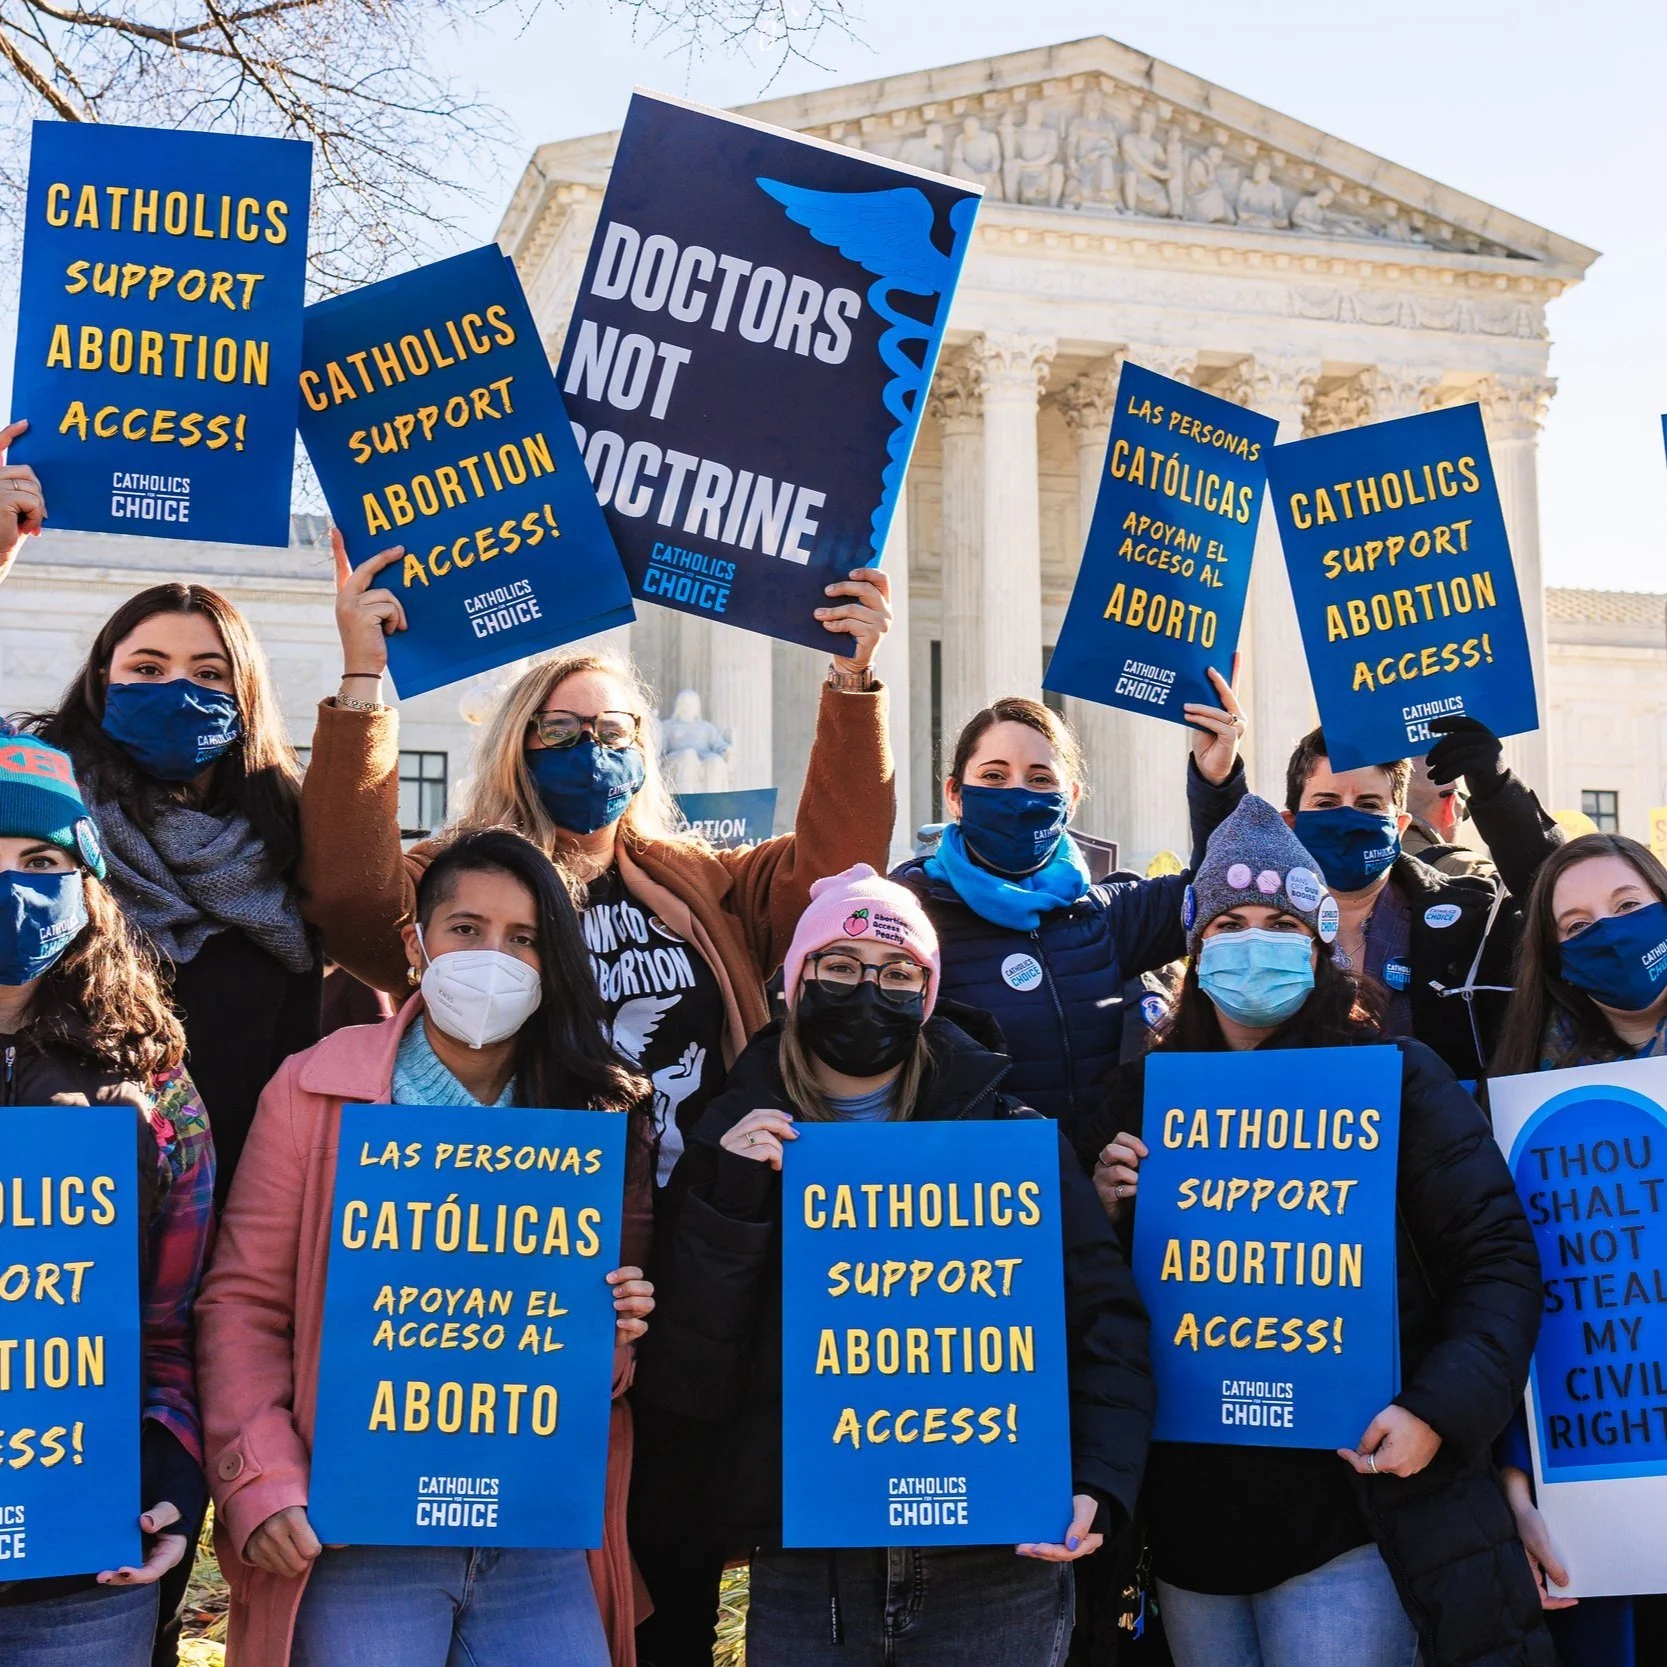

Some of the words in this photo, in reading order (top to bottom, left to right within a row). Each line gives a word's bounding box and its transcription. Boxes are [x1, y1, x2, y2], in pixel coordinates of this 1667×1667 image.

[46, 182, 289, 245] CATHOLICS
[65, 260, 264, 311] SUPPORT
[590, 220, 862, 366] DOCTORS
[46, 324, 269, 386] ABORTION
[299, 304, 517, 412] CATHOLICS
[563, 318, 692, 420] NOT
[59, 401, 247, 451] ACCESS!
[348, 376, 514, 464] SUPPORT
[1128, 396, 1163, 424] LAS
[1169, 411, 1261, 462] PERSONAS
[112, 472, 190, 494] CATHOLICS
[362, 432, 556, 537] ABORTION
[1111, 440, 1253, 524] CATÓLICAS
[1290, 456, 1481, 530] CATHOLICS
[111, 496, 189, 522] CHOICE
[402, 504, 561, 588] ACCESS!
[1123, 512, 1201, 553] APOYAN
[1206, 539, 1228, 562] EL
[1322, 520, 1472, 580] SUPPORT
[651, 542, 736, 580] CATHOLICS
[1118, 538, 1194, 577] ACCESO
[1200, 564, 1224, 588] AL
[464, 579, 532, 614] CATHOLICS
[643, 568, 730, 613] CHOICE
[1326, 571, 1497, 643] ABORTION
[472, 600, 542, 638] CHOICE
[1104, 583, 1217, 649] ABORTO
[1124, 659, 1176, 684] CATHOLICS
[1352, 633, 1494, 693] ACCESS!
[1115, 677, 1170, 705] CHOICE
[1403, 696, 1463, 720] CATHOLICS
[1641, 939, 1667, 965] CATHOL
[1011, 966, 1041, 986] CHOICE
[1163, 1108, 1381, 1151] CATHOLICS
[360, 1141, 423, 1169] LAS
[435, 1143, 603, 1176] PERSONAS
[1530, 1135, 1652, 1181] THOU
[0, 1176, 116, 1226] LICS
[804, 1181, 1041, 1229] CATHOLICS
[1177, 1177, 1358, 1216] SUPPORT
[1529, 1178, 1666, 1226] SHALT
[342, 1194, 601, 1257] CATÓLICAS
[1559, 1225, 1646, 1268] NOT
[827, 1258, 1022, 1298] SUPPORT
[1161, 1238, 1363, 1288] ABORTION
[373, 1285, 512, 1318] APOYAN
[527, 1291, 569, 1318] EL
[1543, 1269, 1667, 1314] STEAL
[373, 1321, 505, 1350] ACCESO
[518, 1325, 564, 1355] AL
[816, 1325, 1035, 1375] ABORTION
[1173, 1312, 1344, 1355] ACCESS!
[1583, 1316, 1643, 1356] MY
[0, 1336, 105, 1391] TION
[1566, 1360, 1667, 1402] CIVIL
[369, 1380, 559, 1436] ABORTO
[1222, 1380, 1293, 1399] CATHOLICS
[832, 1403, 1018, 1449] ACCESS!
[1221, 1403, 1294, 1428] CHOICE
[0, 1421, 84, 1469] SS!
[418, 1476, 499, 1496] CATHOLICS
[889, 1476, 967, 1495] CATHOLICS
[416, 1501, 498, 1528] CHOICE
[889, 1501, 968, 1526] CHOICE
